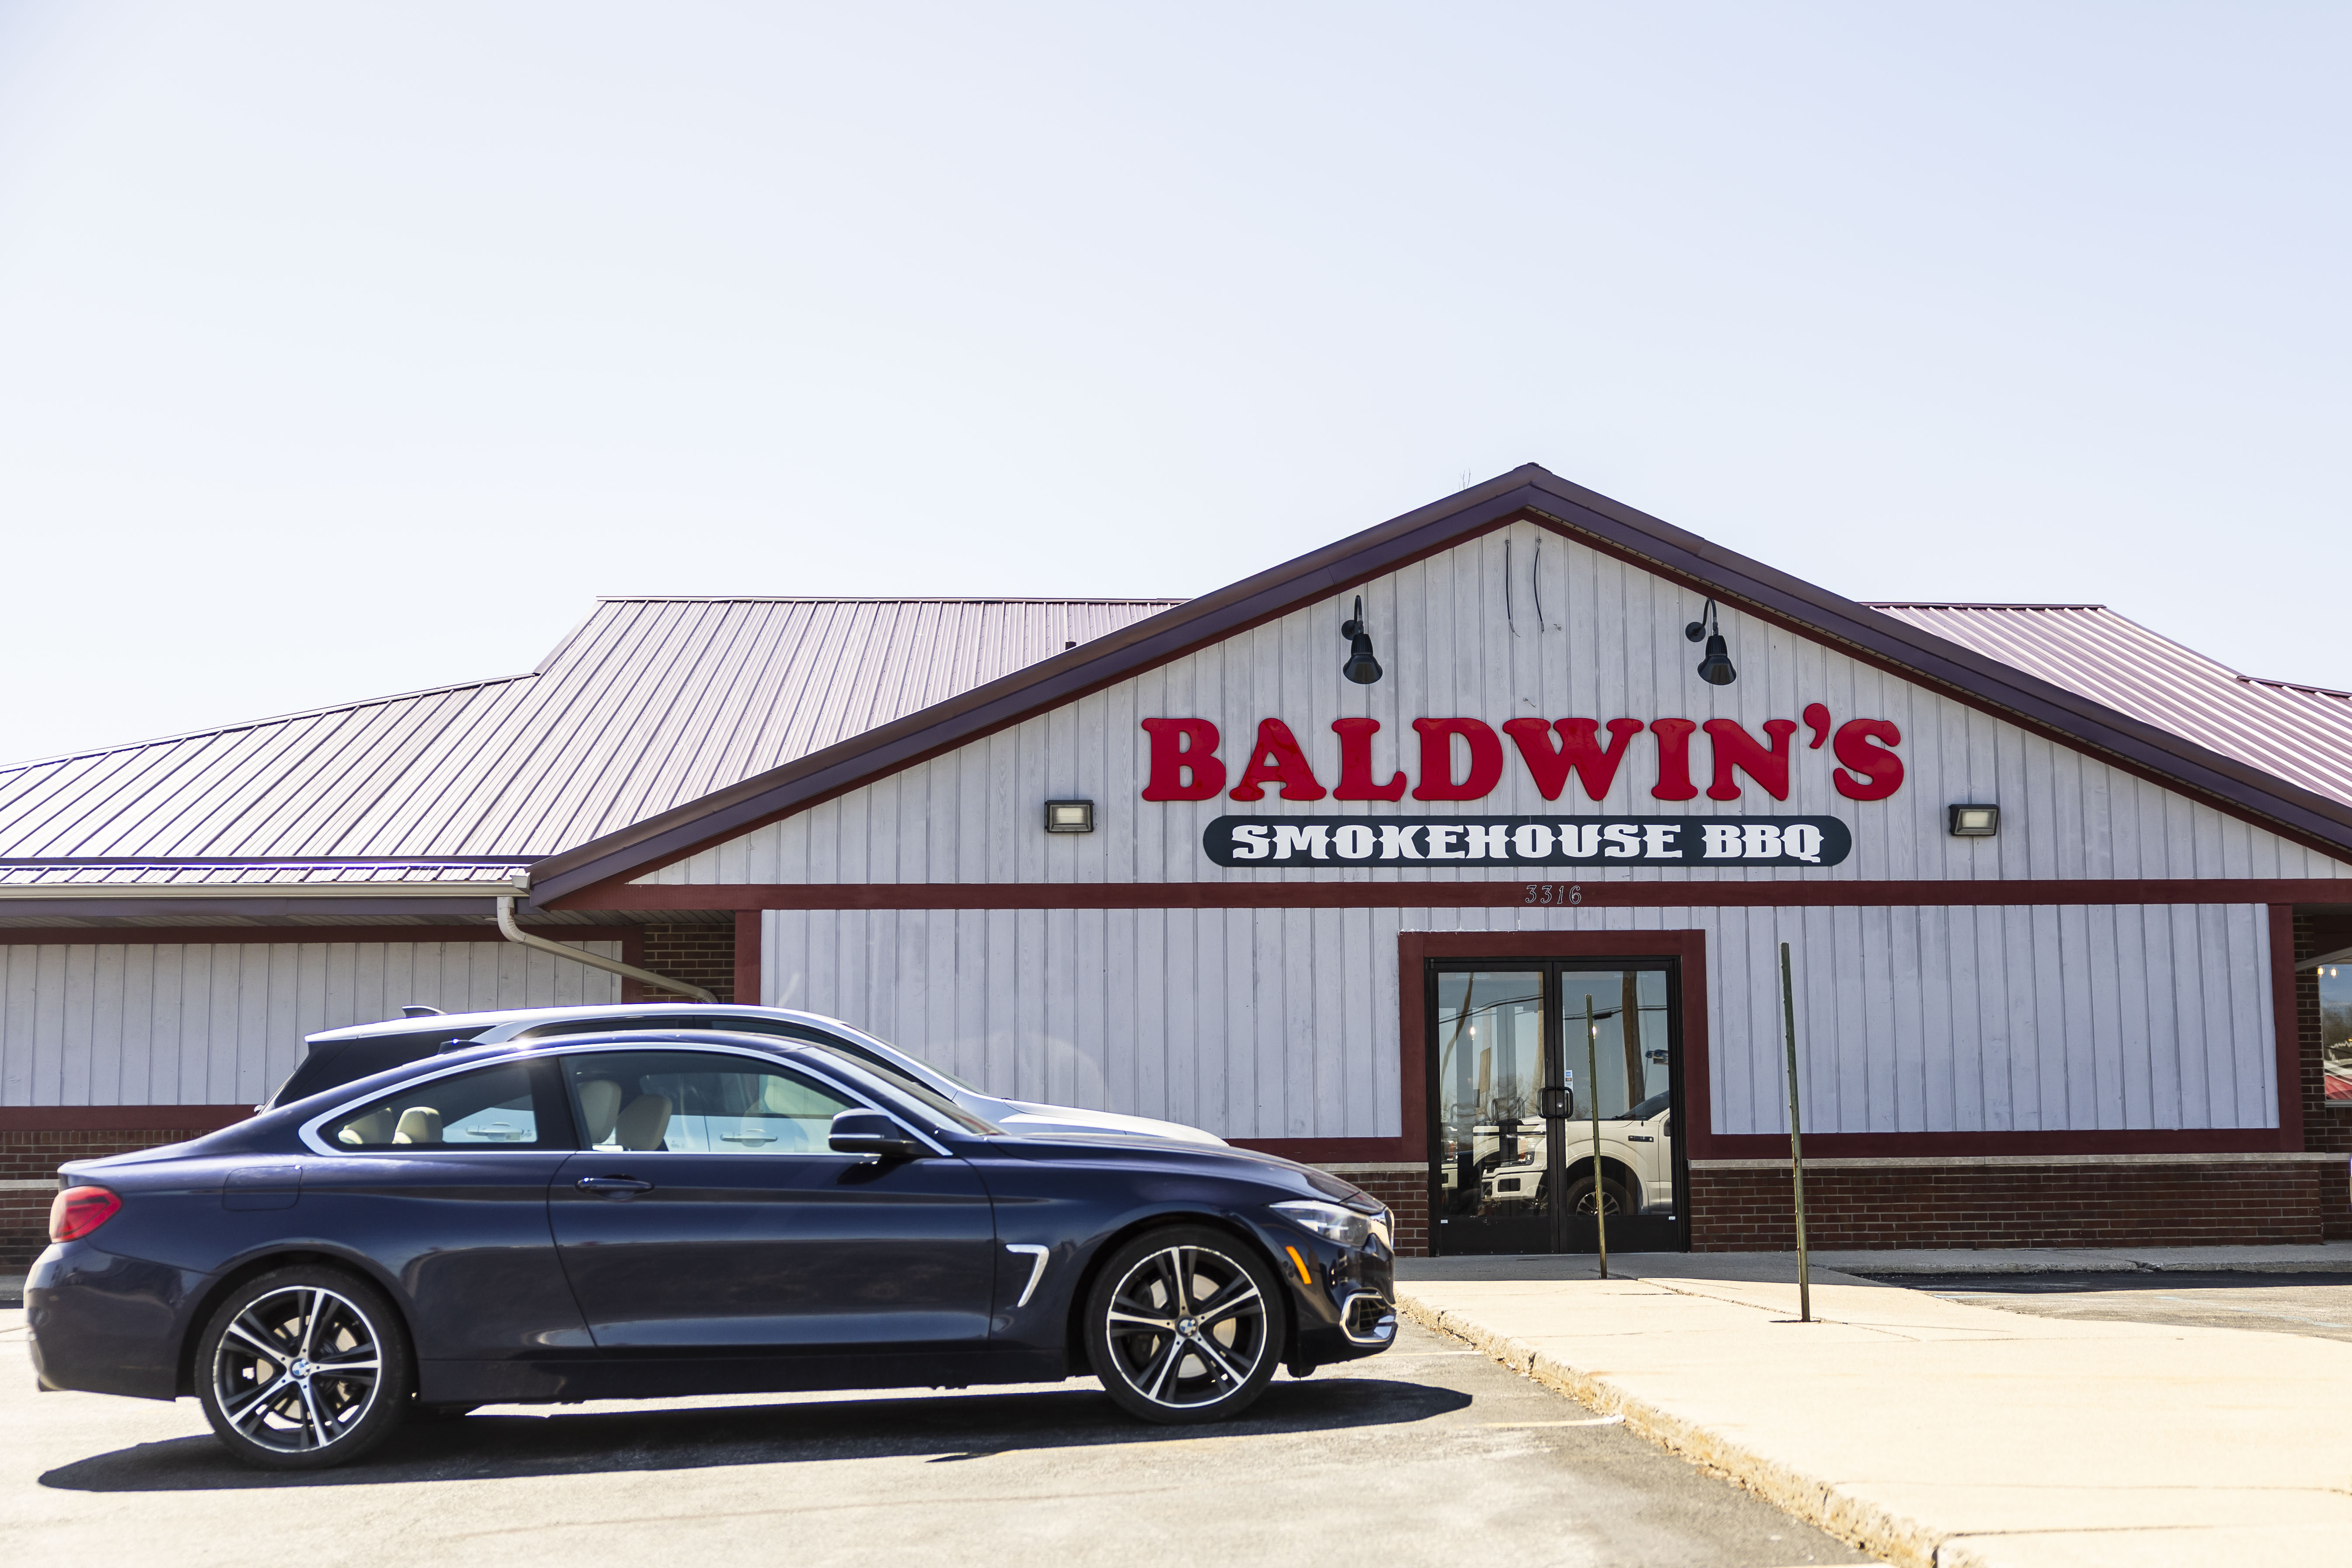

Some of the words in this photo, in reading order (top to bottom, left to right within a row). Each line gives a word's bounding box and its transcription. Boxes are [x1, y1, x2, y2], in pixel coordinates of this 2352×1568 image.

[1141, 703, 1905, 801] BALDWIN'S
[1231, 824, 1683, 859] SMOKEHOUSE
[1701, 824, 1825, 863] BBQ
[1525, 885, 1582, 904] 3316
